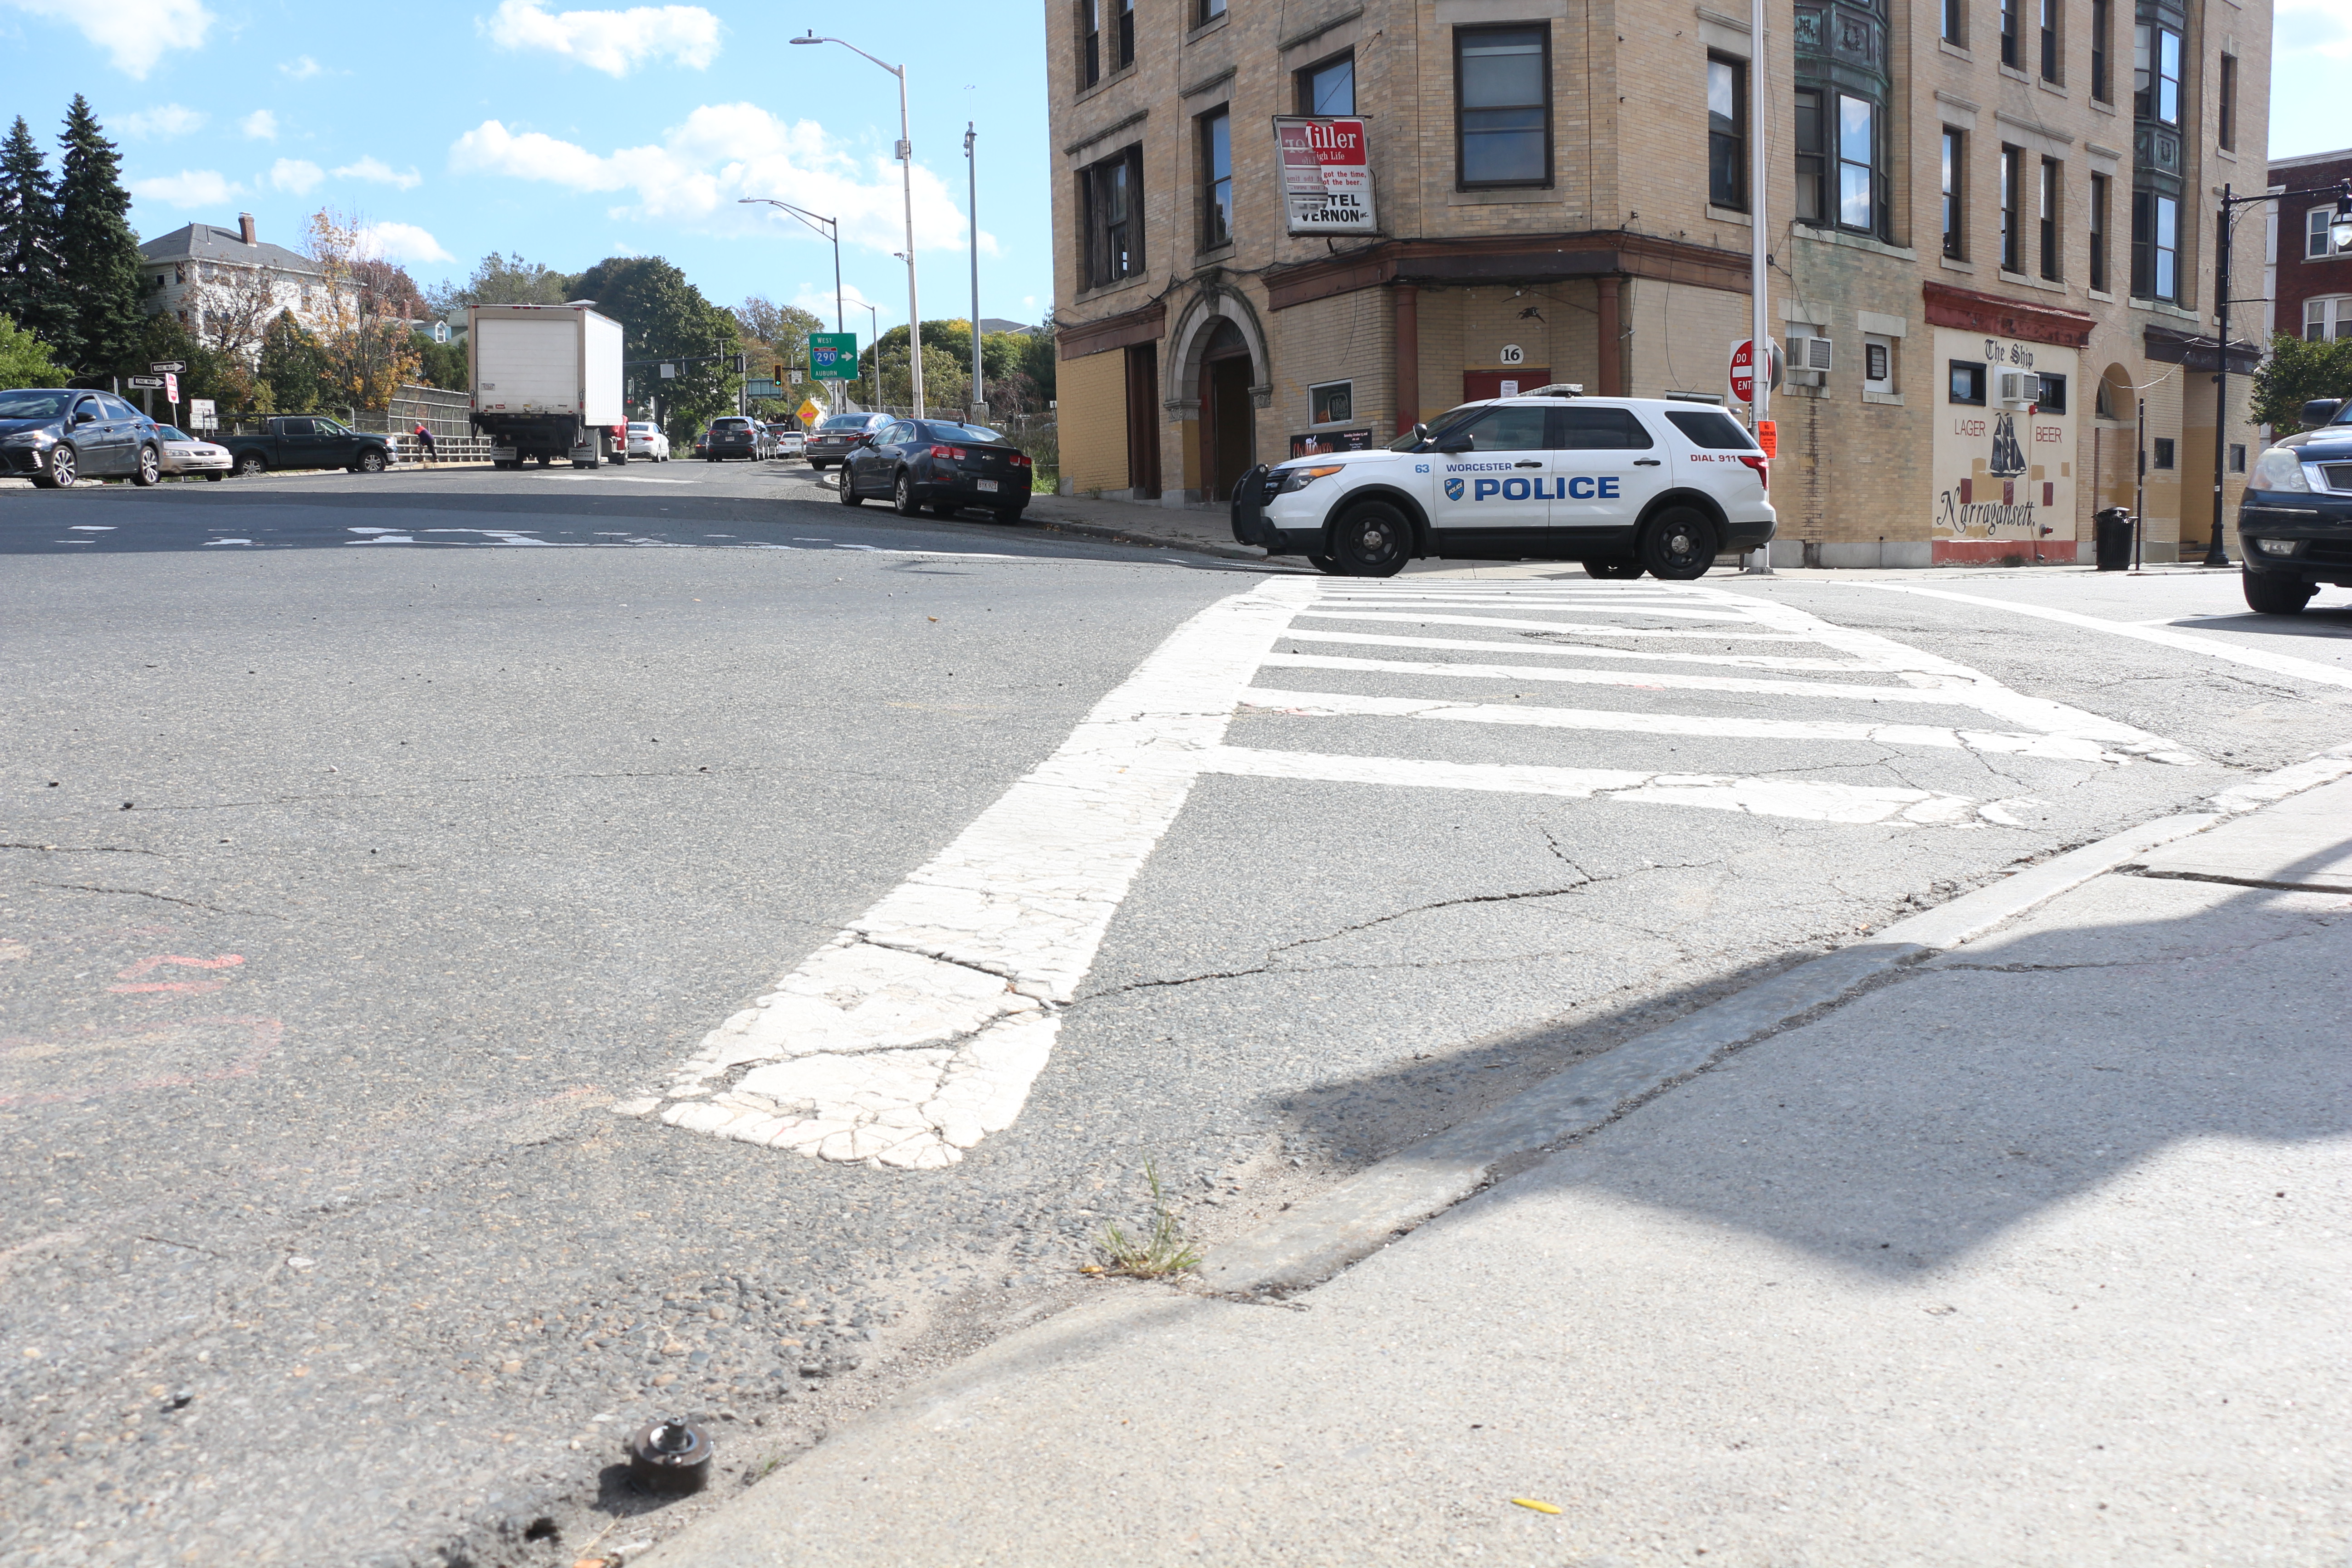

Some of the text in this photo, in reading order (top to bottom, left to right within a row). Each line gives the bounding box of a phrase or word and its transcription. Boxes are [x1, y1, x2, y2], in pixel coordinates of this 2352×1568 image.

[1317, 151, 1345, 162] igh Life
[1328, 194, 1360, 206] TEL
[1302, 209, 1359, 222] VERNON
[817, 353, 835, 362] 290
[1504, 348, 1520, 361] 16
[1736, 353, 1746, 363] DO
[1984, 339, 2033, 370] The Ship
[1738, 380, 1752, 390] ENT
[1955, 419, 2062, 443] LAGER BEER
[1415, 464, 1430, 473] 63
[1446, 463, 1512, 472] WORCESTER
[1448, 481, 1463, 495] POLICE
[1475, 476, 1620, 501] POLICE
[1936, 486, 2035, 535] Narragansett.
